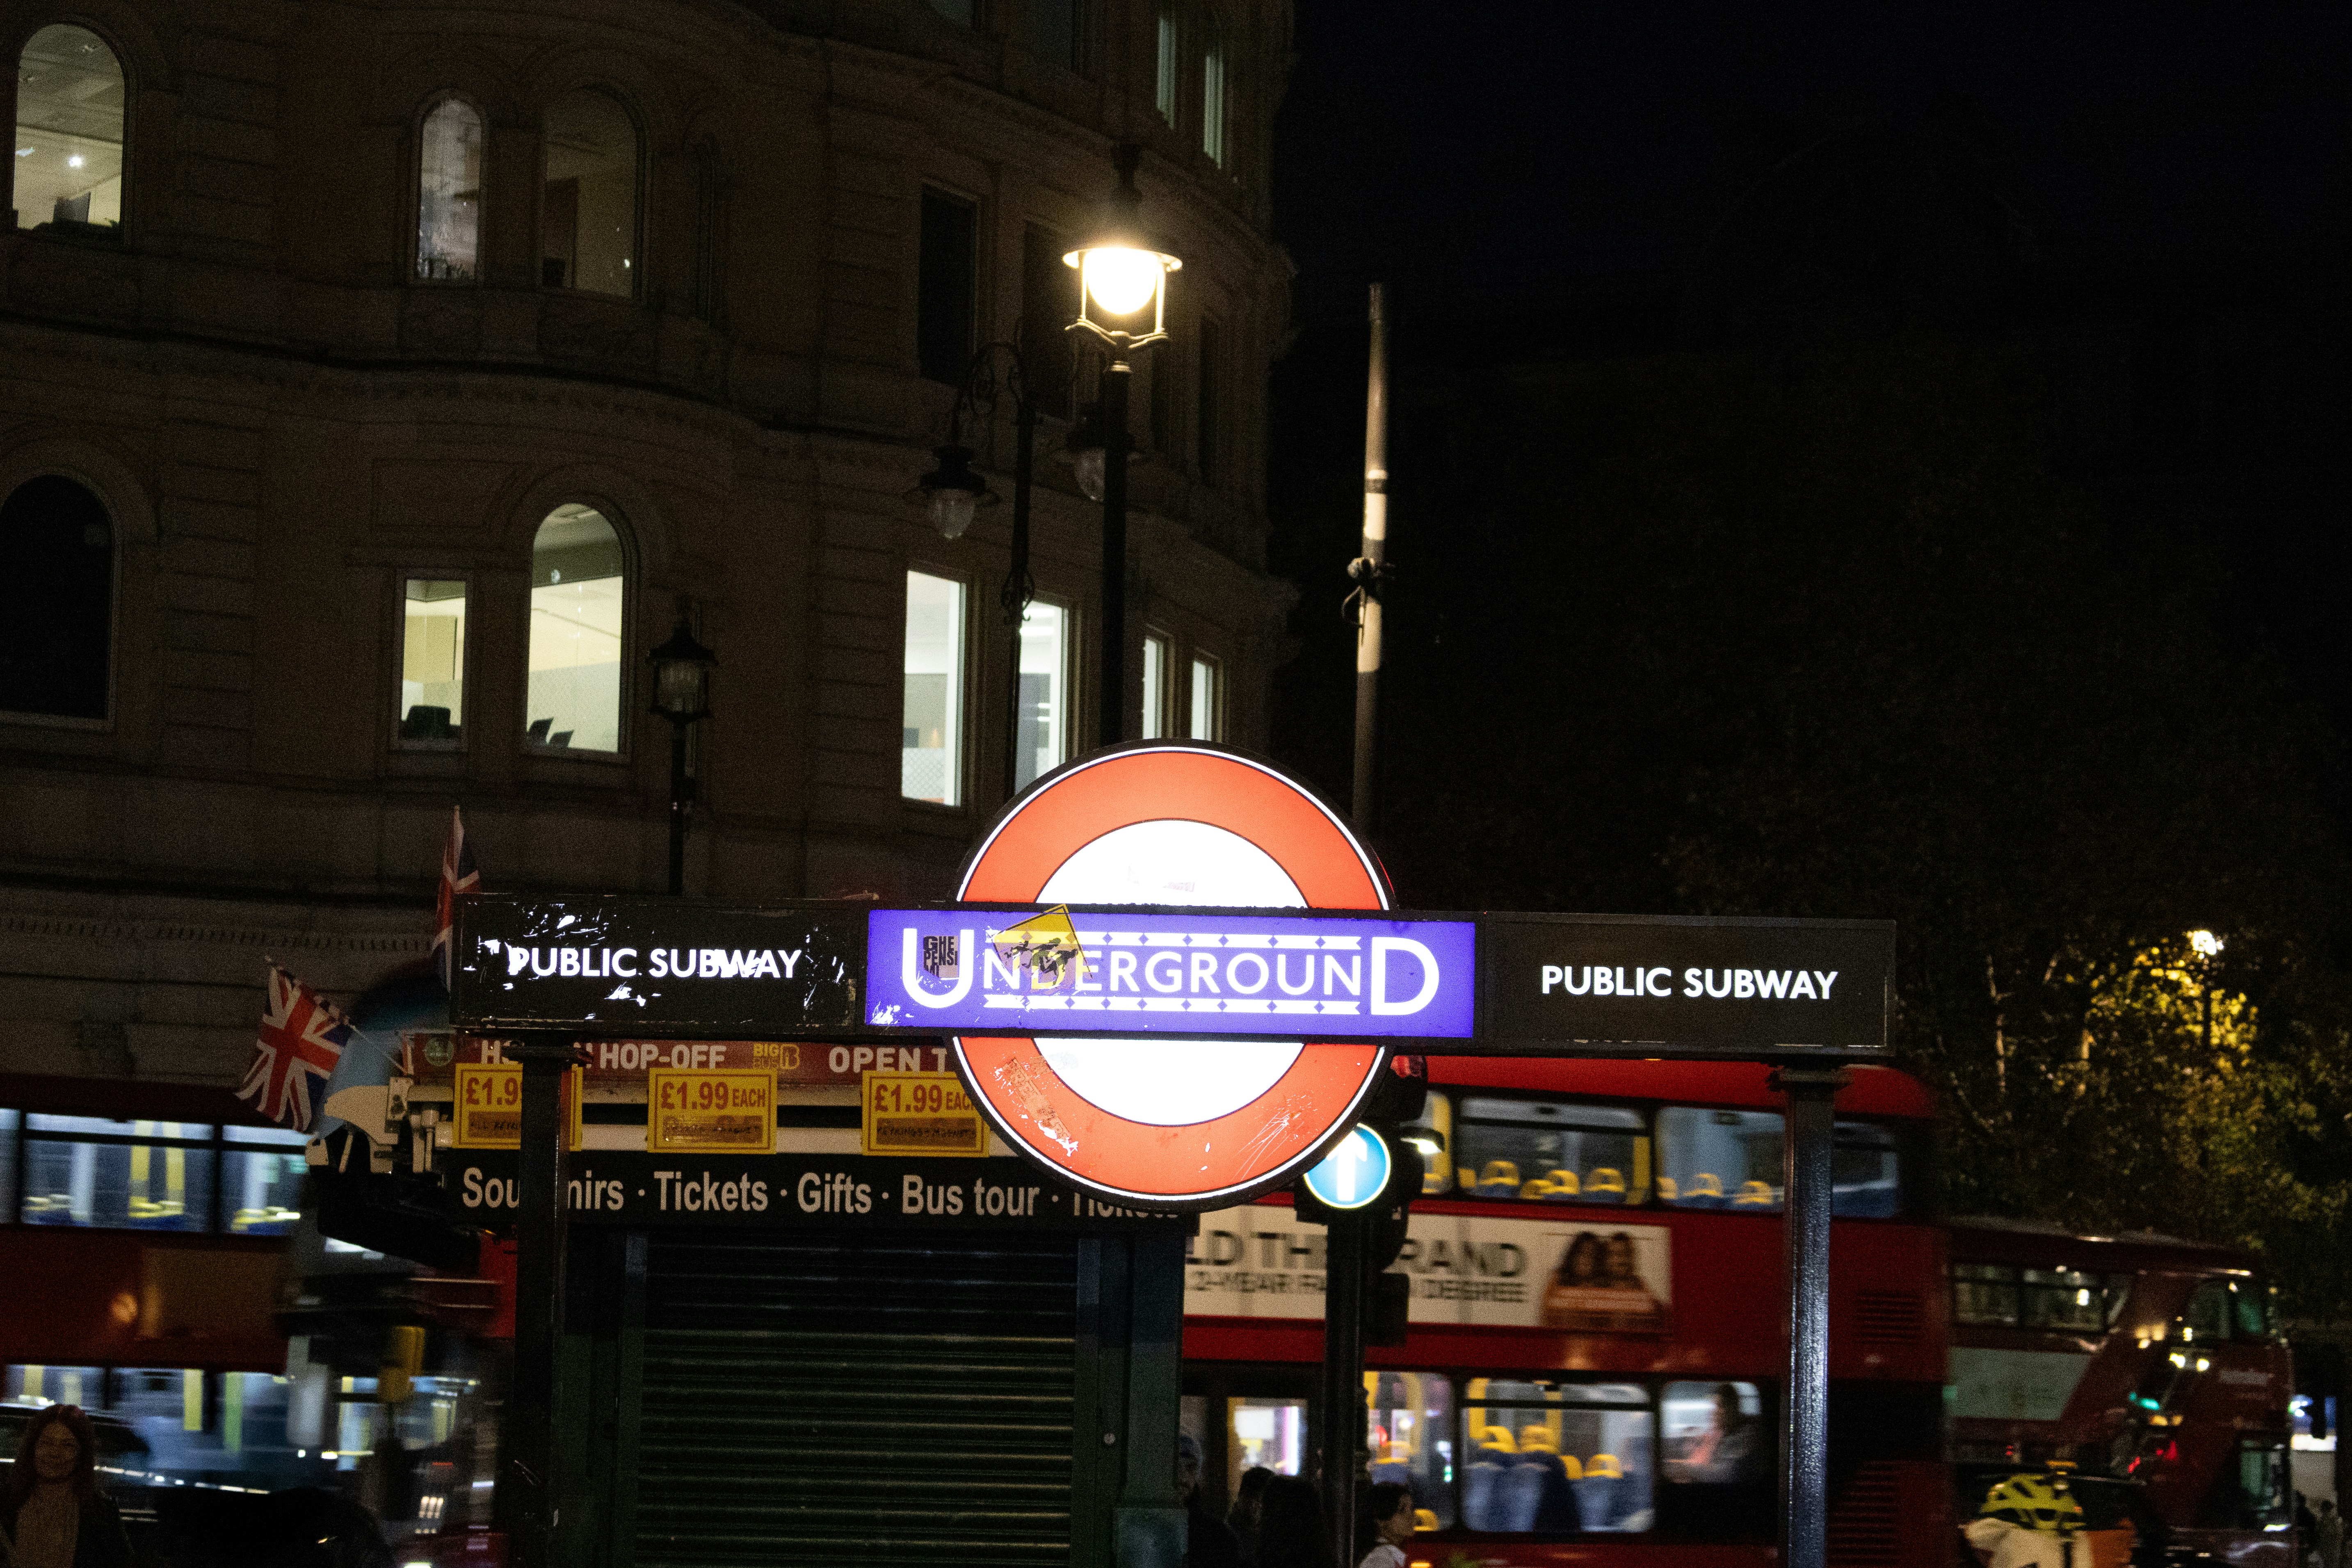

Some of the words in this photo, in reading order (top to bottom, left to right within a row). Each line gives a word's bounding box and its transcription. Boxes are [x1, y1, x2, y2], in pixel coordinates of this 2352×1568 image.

[505, 943, 637, 978] PUBLIC
[649, 948, 802, 978] SUBWAY
[902, 928, 1440, 1016] UNDERGROUND
[1542, 965, 1672, 997] PUBLIC
[1683, 968, 1838, 1000] SUBWAY
[600, 1043, 727, 1070] HOP-OFF
[754, 1043, 779, 1057] BIG
[829, 1046, 920, 1074] OPEN
[931, 1048, 948, 1077] T
[466, 1077, 522, 1105] £1.9
[661, 1081, 729, 1110] £1.99
[732, 1088, 766, 1108] EACH
[875, 1084, 943, 1113] £1.99
[946, 1091, 975, 1111] EAC
[462, 1167, 624, 1210] Sounirs
[654, 1171, 768, 1211] Tickets
[797, 1172, 872, 1214] Gifts
[902, 1175, 963, 1215] Bus
[974, 1178, 1040, 1216] tour
[1251, 1232, 1328, 1270] TH
[1394, 1238, 1530, 1277] RAND
